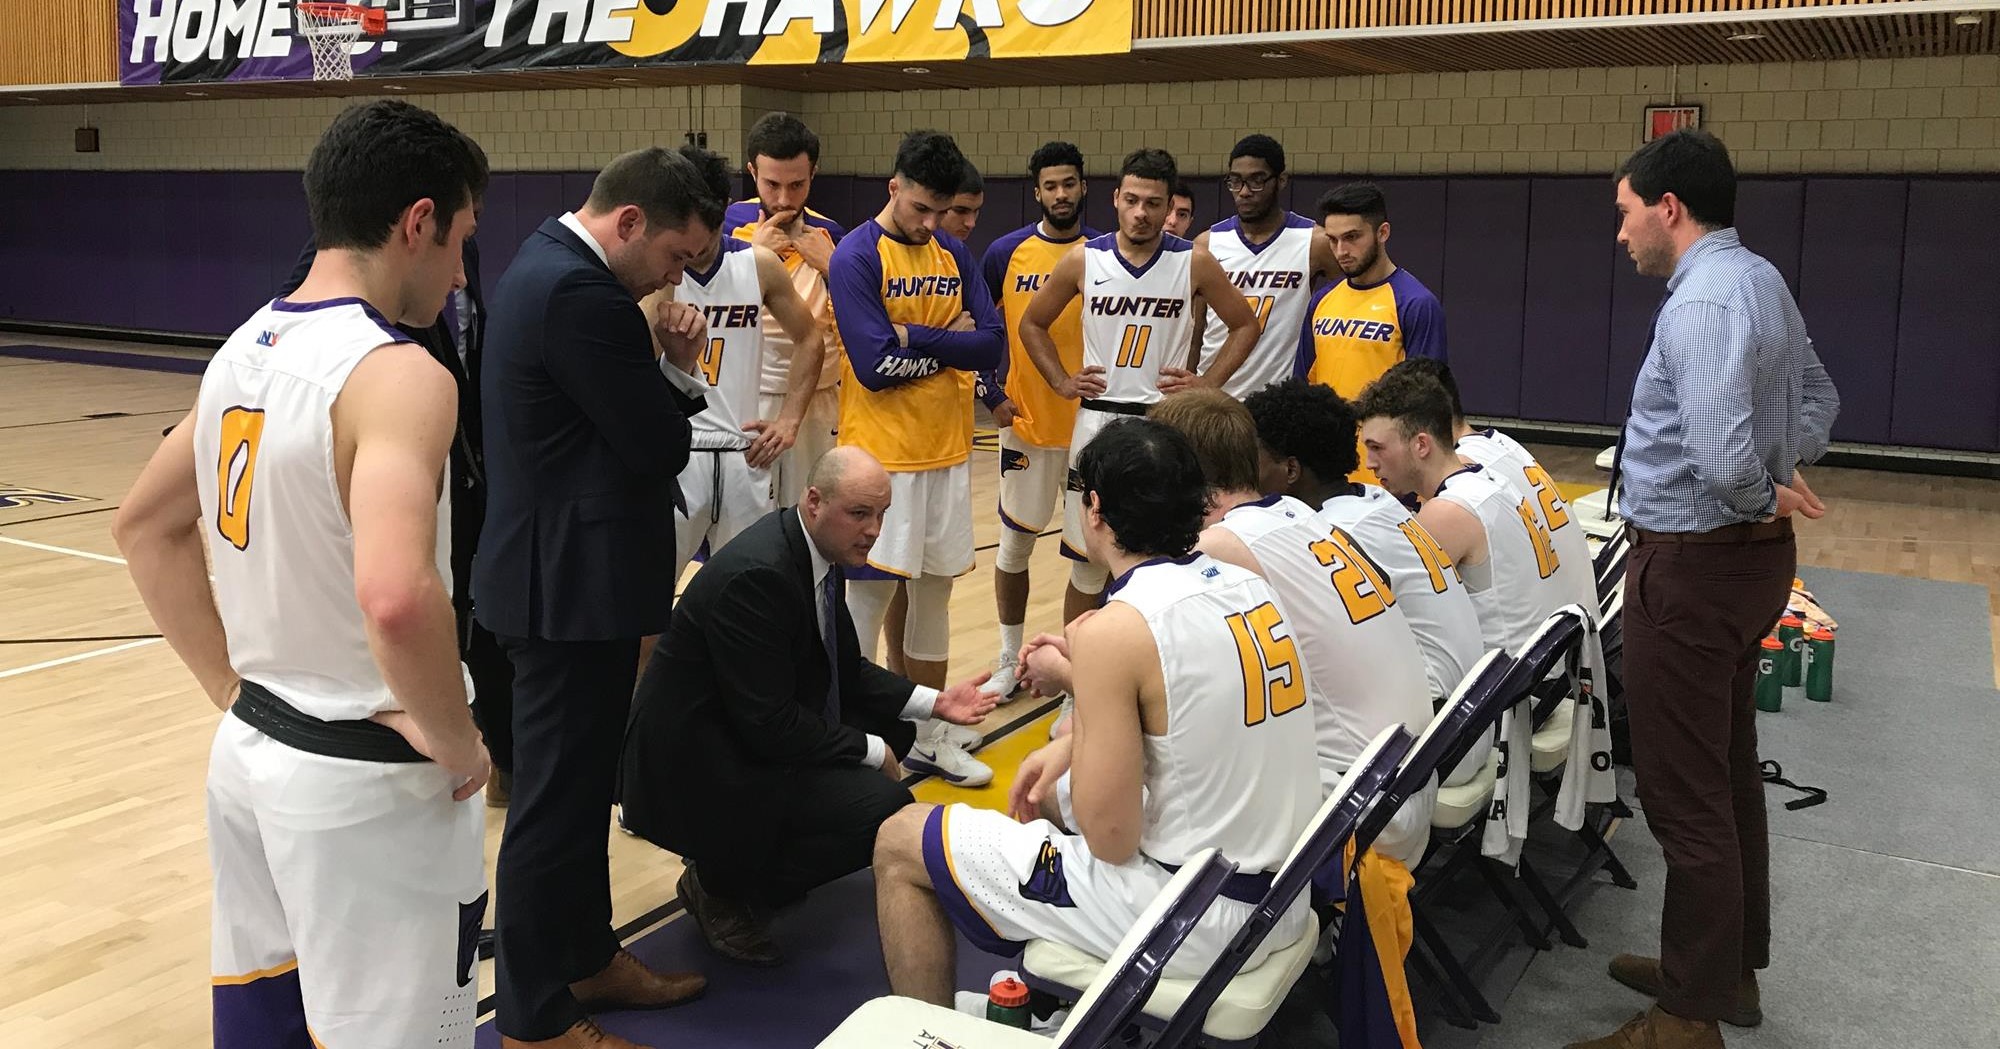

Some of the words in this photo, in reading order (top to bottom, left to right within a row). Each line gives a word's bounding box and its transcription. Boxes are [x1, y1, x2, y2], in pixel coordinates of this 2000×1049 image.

[130, 0, 292, 63] HOME
[885, 275, 961, 298] HUNTER
[1225, 271, 1303, 289] UNTER
[1091, 296, 1184, 319] HUNTER
[1313, 317, 1395, 343] HUNTER
[1116, 324, 1152, 369] 11
[875, 355, 940, 378] HAWKS
[217, 405, 266, 551] 0
[1224, 601, 1307, 727] 15
[1759, 658, 1773, 675] G
